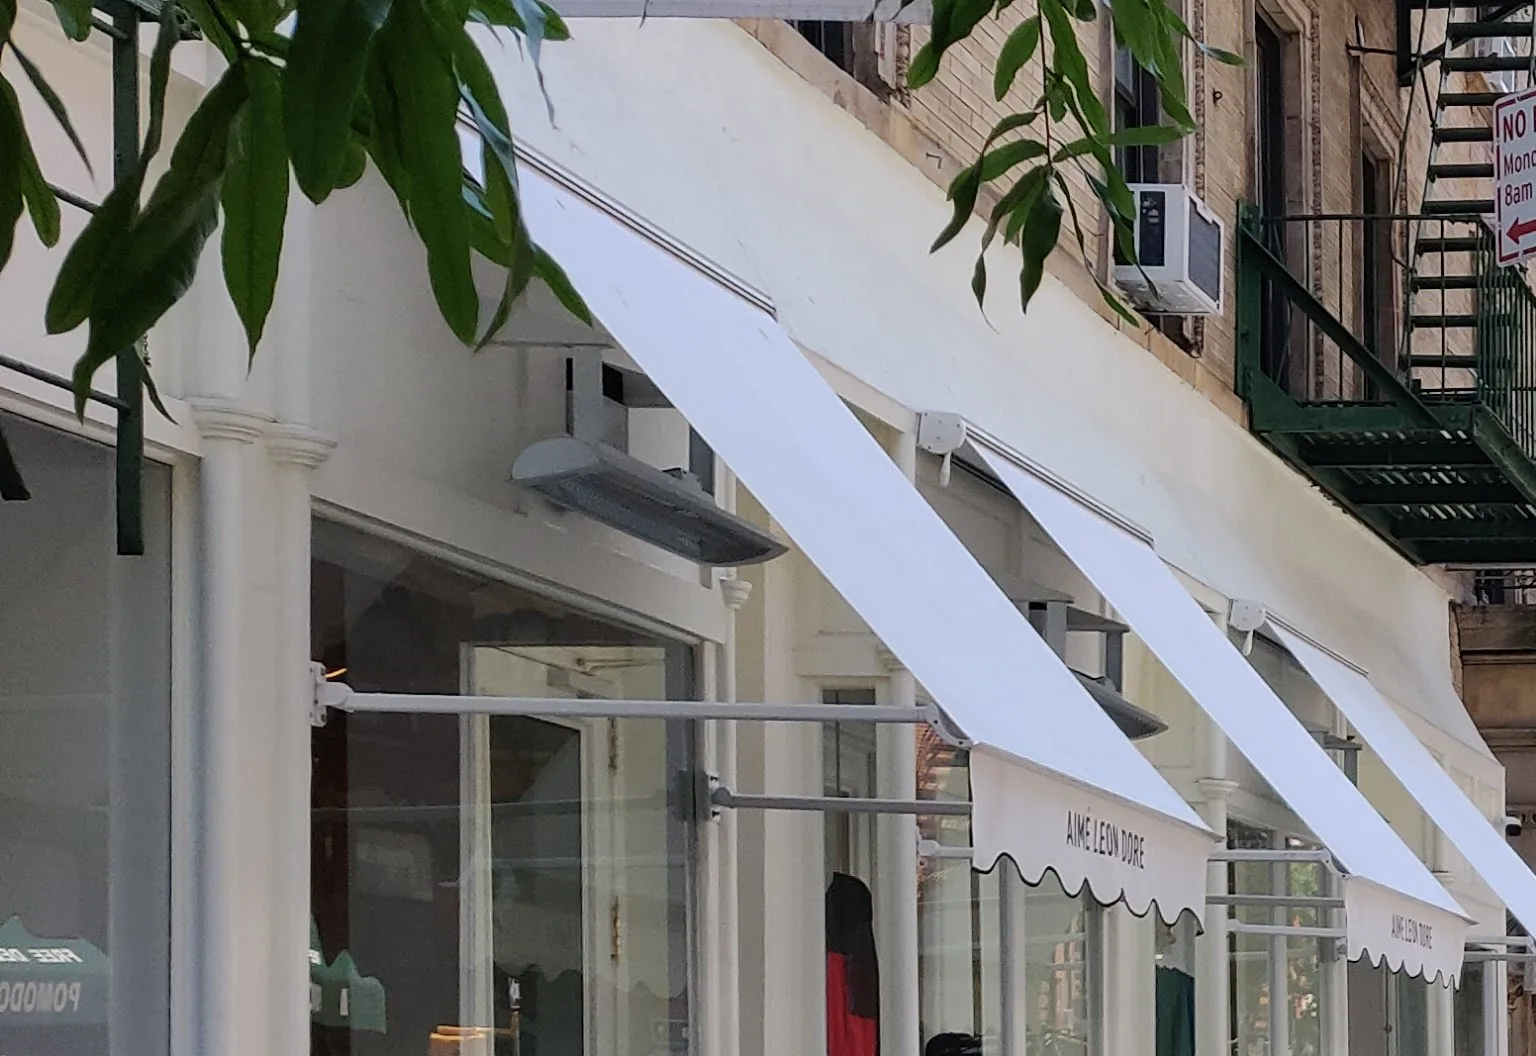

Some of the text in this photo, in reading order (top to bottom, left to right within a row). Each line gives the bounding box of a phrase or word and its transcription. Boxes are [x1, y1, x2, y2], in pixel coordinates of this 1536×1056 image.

[1503, 109, 1526, 143] NO
[1505, 181, 1533, 207] 8am
[1093, 819, 1119, 858] LEON
[1121, 829, 1145, 869] DORE
